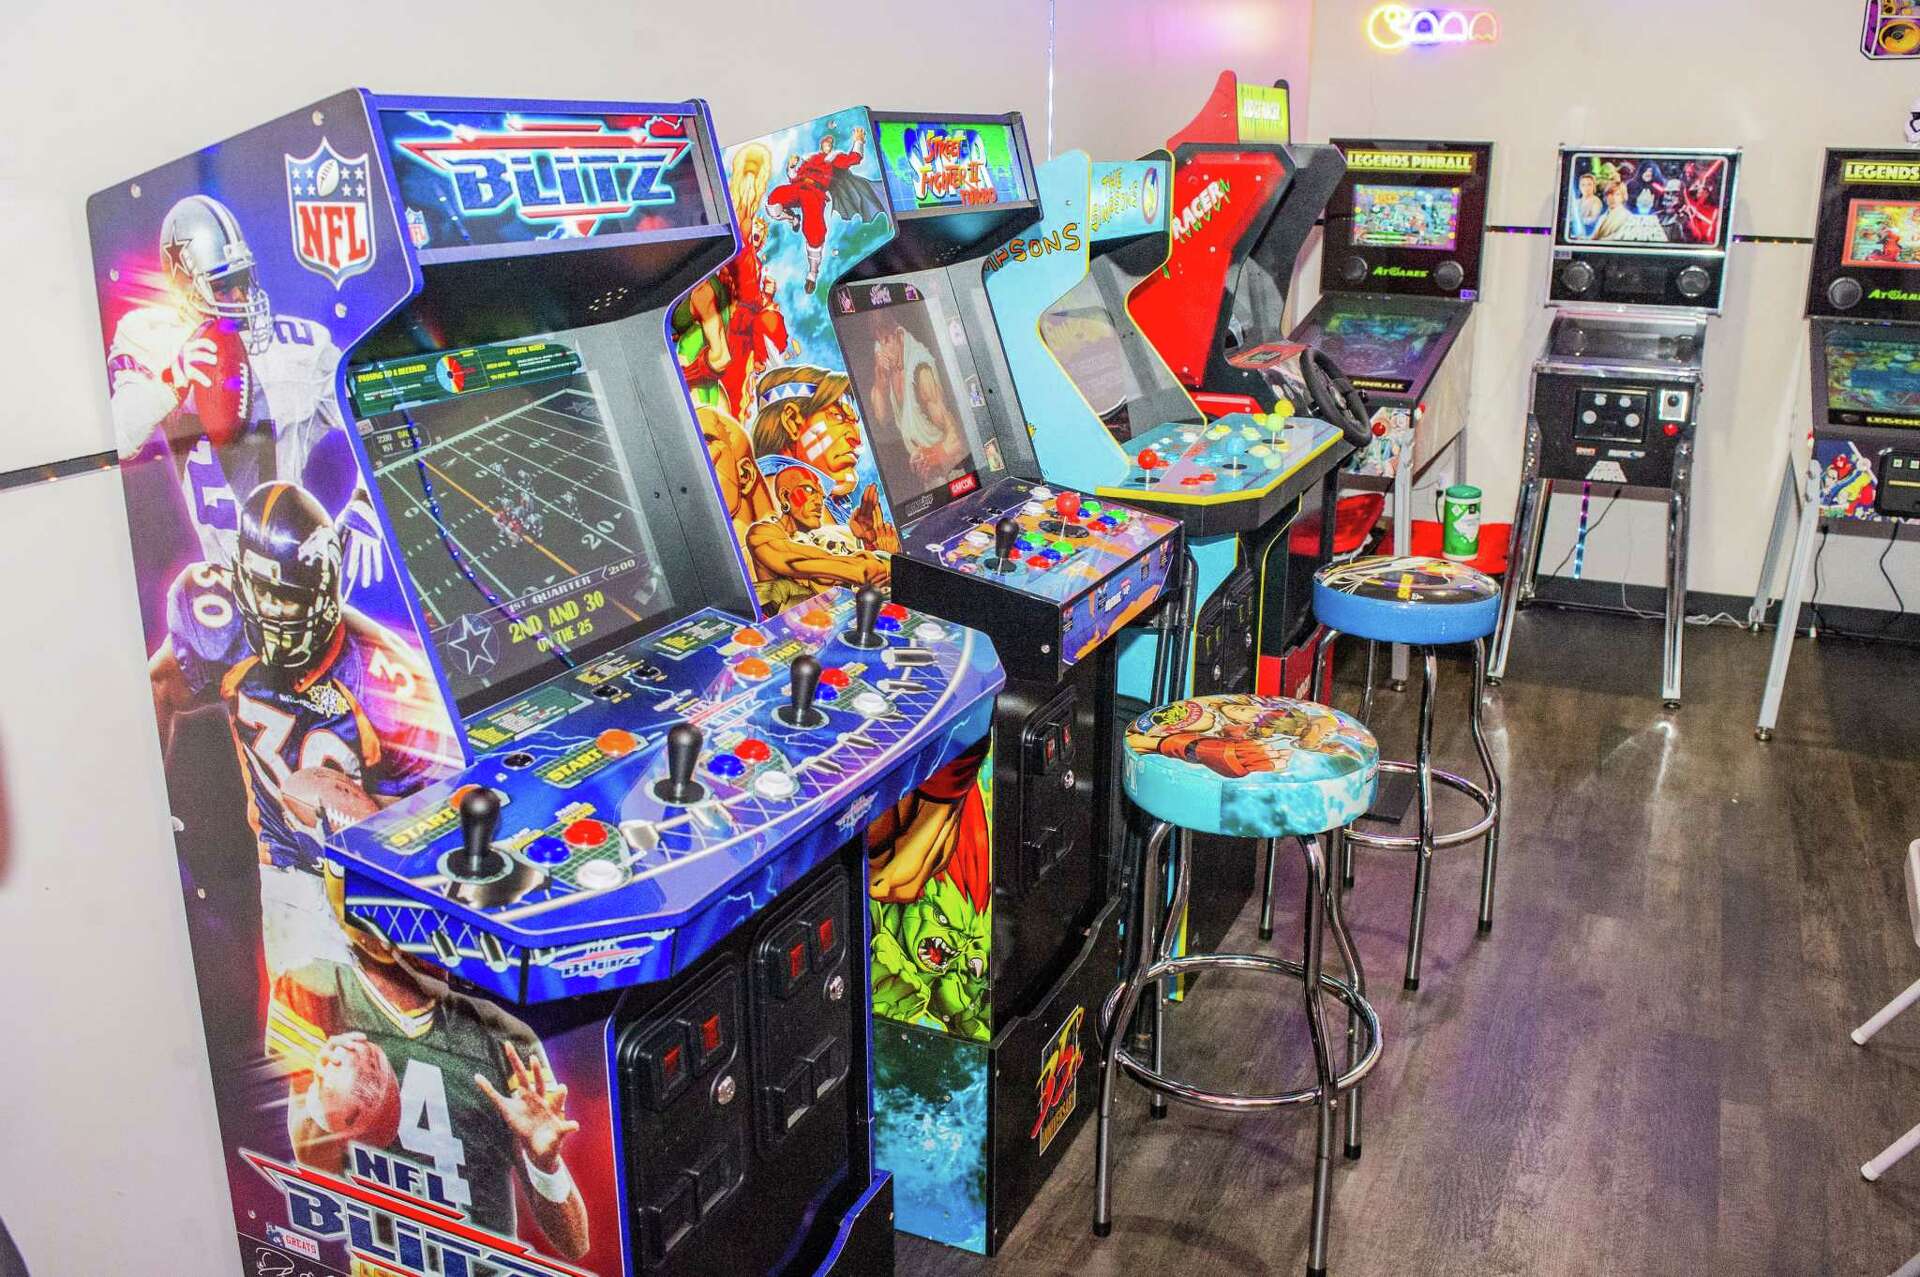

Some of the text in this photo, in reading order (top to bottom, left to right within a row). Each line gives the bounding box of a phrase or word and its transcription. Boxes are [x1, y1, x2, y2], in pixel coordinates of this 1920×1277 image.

[444, 150, 675, 212] BLITZ
[1349, 153, 1472, 168] LEGENDS PINBALL
[1844, 165, 1920, 180] LEGENDS
[1172, 180, 1229, 241] RACER
[298, 206, 367, 268] NFL
[1353, 380, 1404, 391] PINBALL
[509, 559, 636, 613] 1ST QUARTER 2:00
[508, 590, 605, 644] 2ND AND 30
[577, 618, 594, 636] 25
[547, 748, 604, 782] START
[390, 806, 459, 846] START
[399, 1057, 471, 1206] 4
[353, 1146, 458, 1208] NFL
[286, 1234, 317, 1256] GREATS
